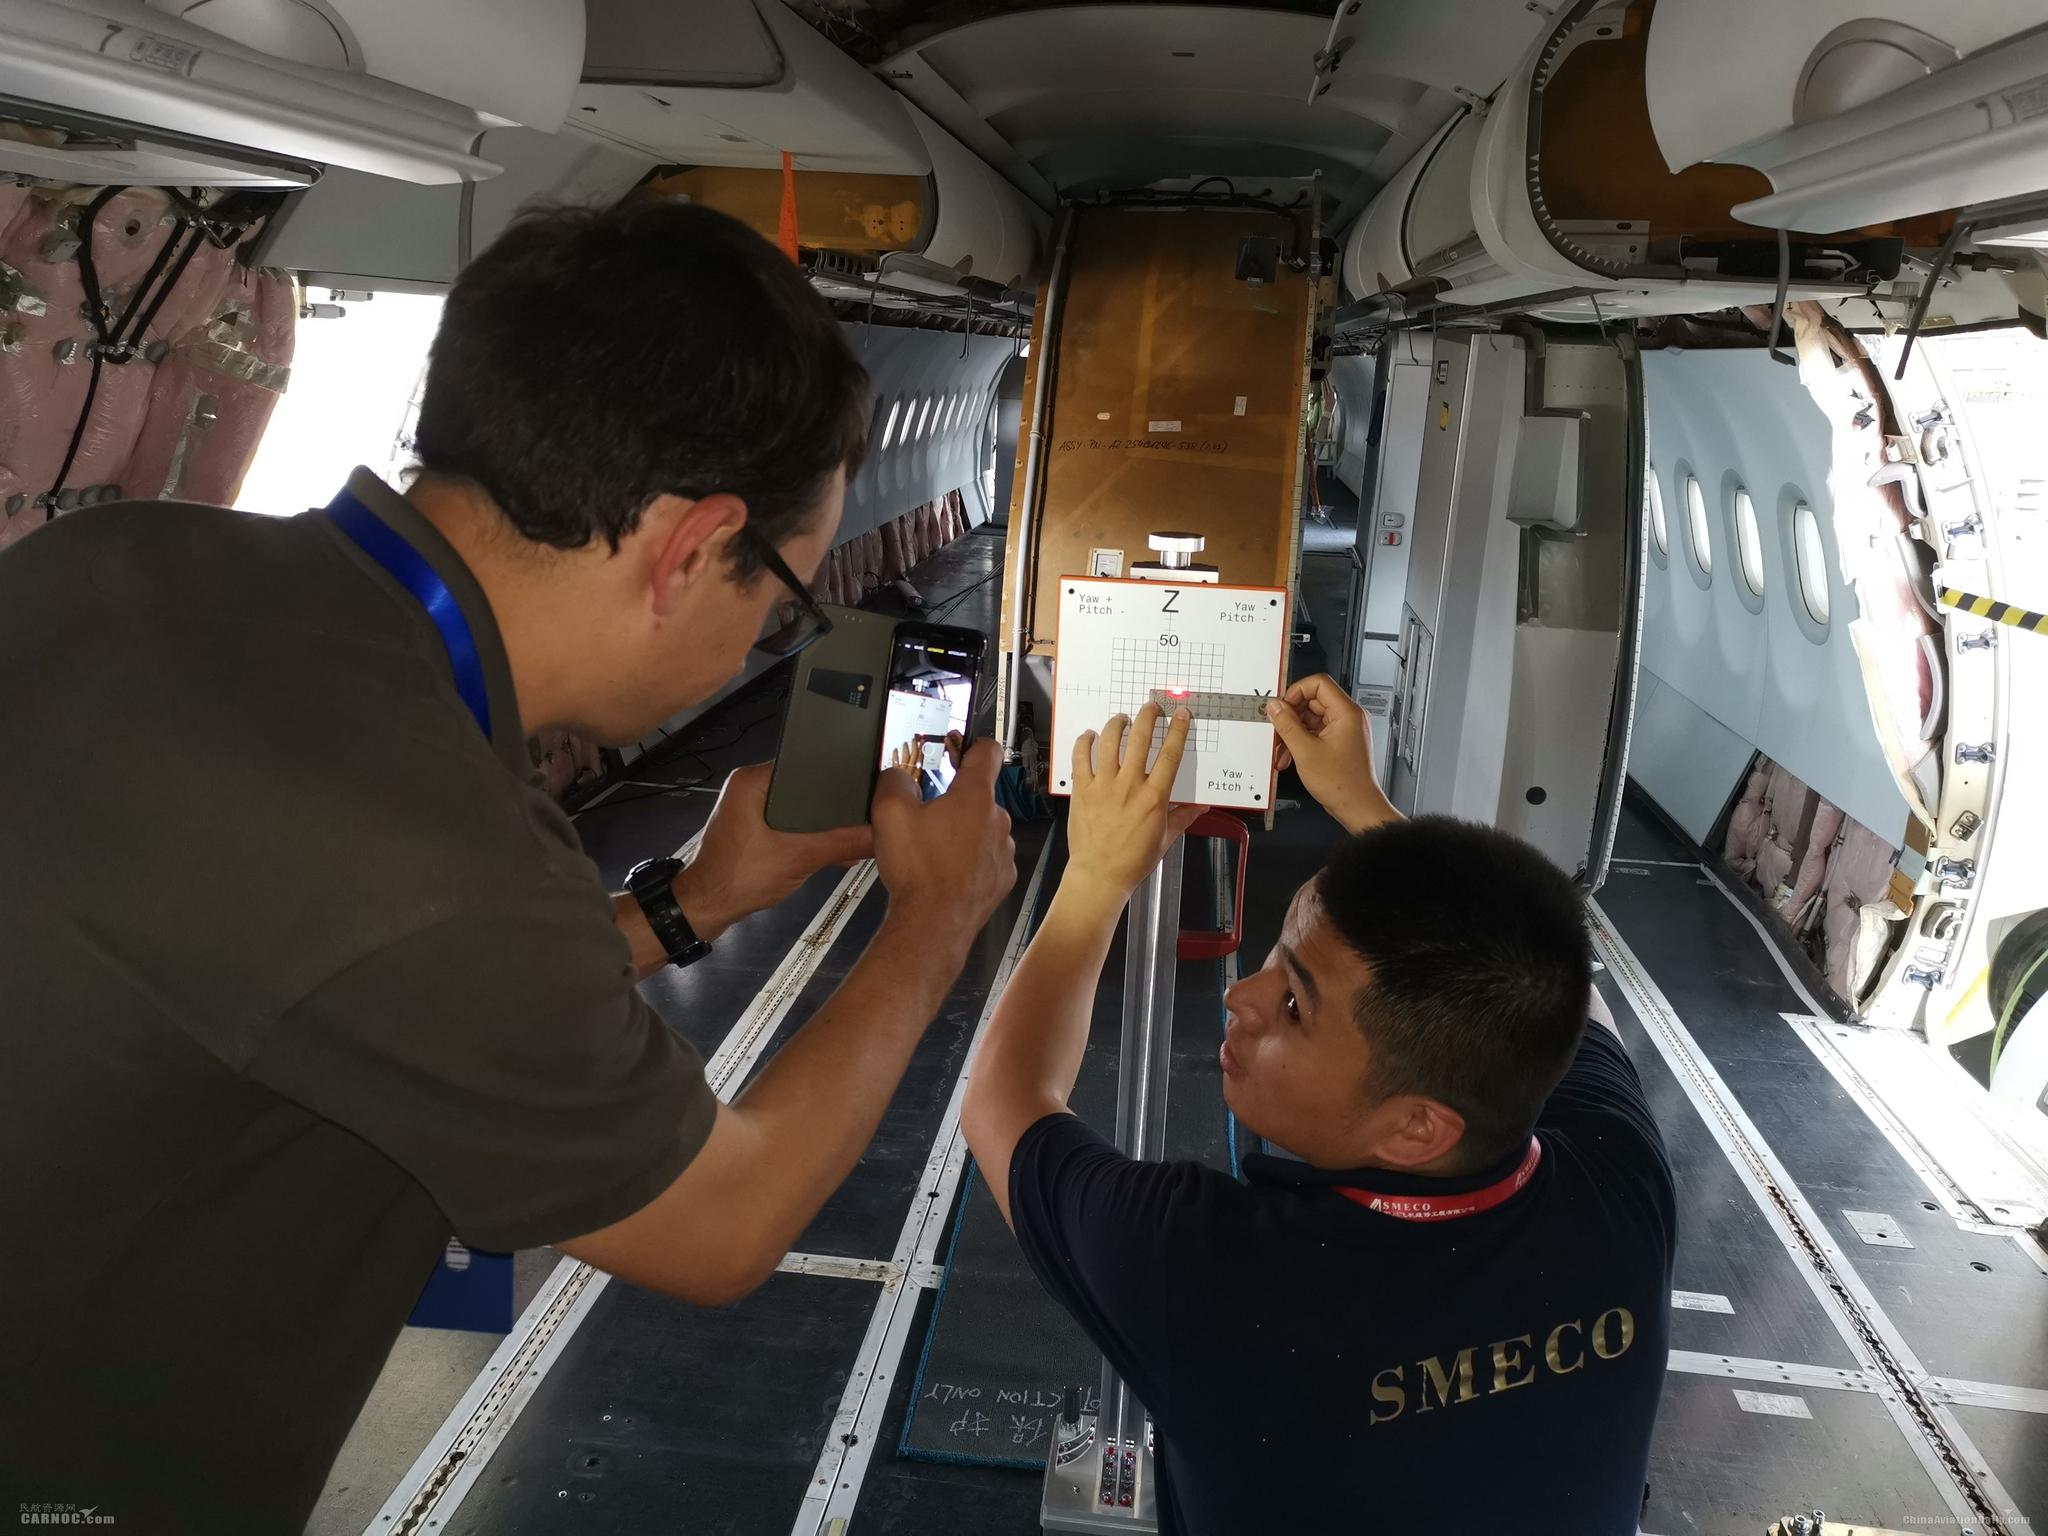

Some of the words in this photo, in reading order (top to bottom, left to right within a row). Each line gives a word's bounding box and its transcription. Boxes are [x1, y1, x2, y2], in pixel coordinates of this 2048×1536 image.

[1079, 593, 1100, 604] Yaw
[1162, 590, 1180, 613] Z
[1079, 604, 1113, 616] Pitch
[1234, 601, 1256, 612] Yaw
[1220, 612, 1254, 623] Pitch
[1159, 634, 1179, 647] 50
[1222, 769, 1243, 779] Yaw
[1208, 780, 1242, 793] Pitch
[1383, 1201, 1431, 1212] SMECO
[1369, 1306, 1635, 1426] SMECO
[924, 1383, 982, 1405] ONLY
